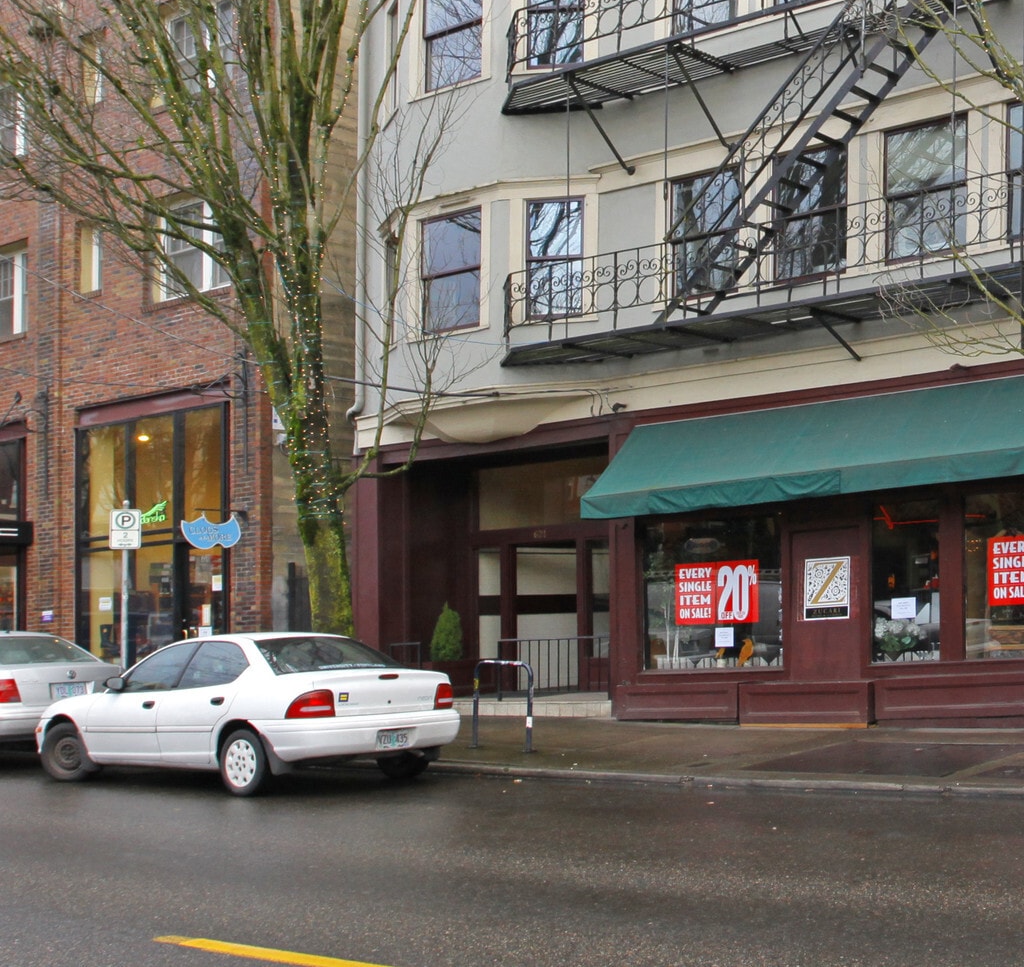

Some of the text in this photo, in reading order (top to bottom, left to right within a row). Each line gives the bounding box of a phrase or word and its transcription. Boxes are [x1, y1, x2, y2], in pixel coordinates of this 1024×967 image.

[121, 516, 131, 526] P
[679, 567, 712, 579] EVERY
[679, 581, 712, 593] SINGLE
[810, 561, 847, 605] Z
[717, 564, 757, 621] 20%
[993, 587, 1007, 599] ON
[680, 594, 711, 606] ITEM
[680, 607, 712, 619] ON SALE!
[721, 611, 733, 620] OFF
